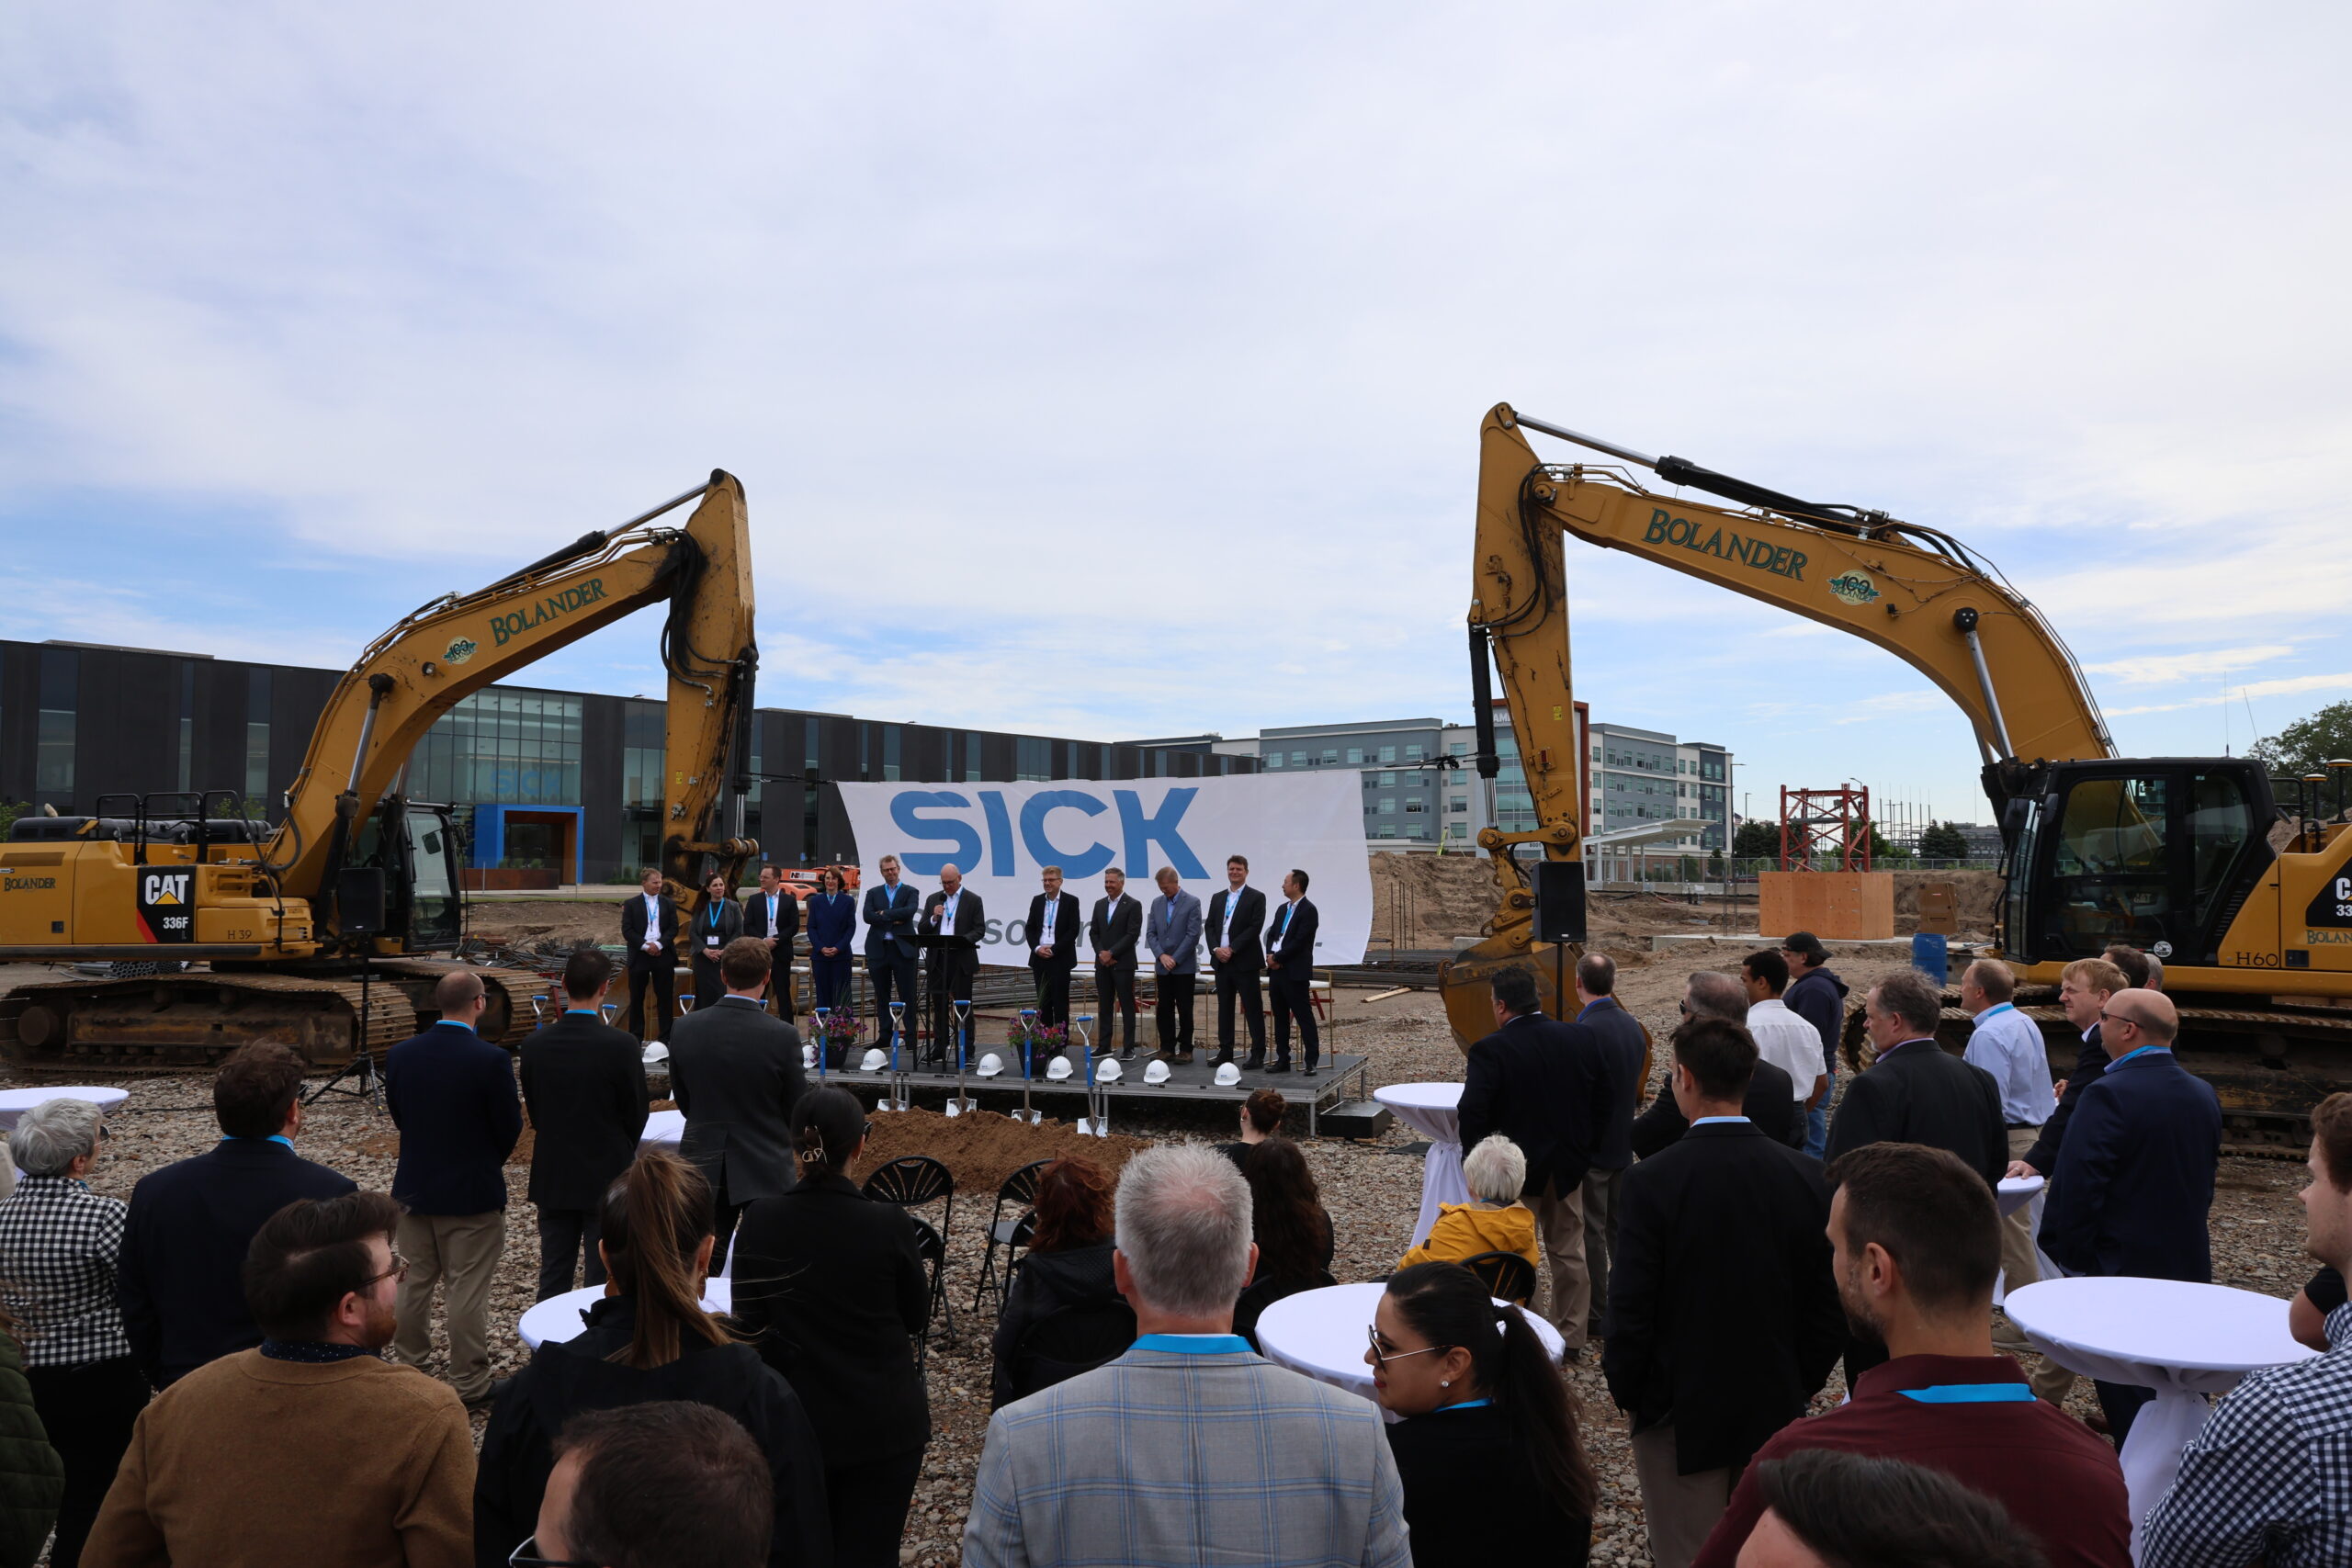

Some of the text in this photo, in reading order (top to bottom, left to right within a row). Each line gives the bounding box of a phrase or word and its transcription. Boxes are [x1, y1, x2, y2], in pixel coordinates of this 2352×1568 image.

[1641, 507, 1808, 581] BOLANDER
[489, 578, 608, 648] BOLANDER
[889, 787, 1211, 879] SICK
[4, 877, 56, 892] BOLANDER
[145, 874, 189, 905] CAT
[163, 917, 189, 929] 336F
[2235, 952, 2278, 967] H60
